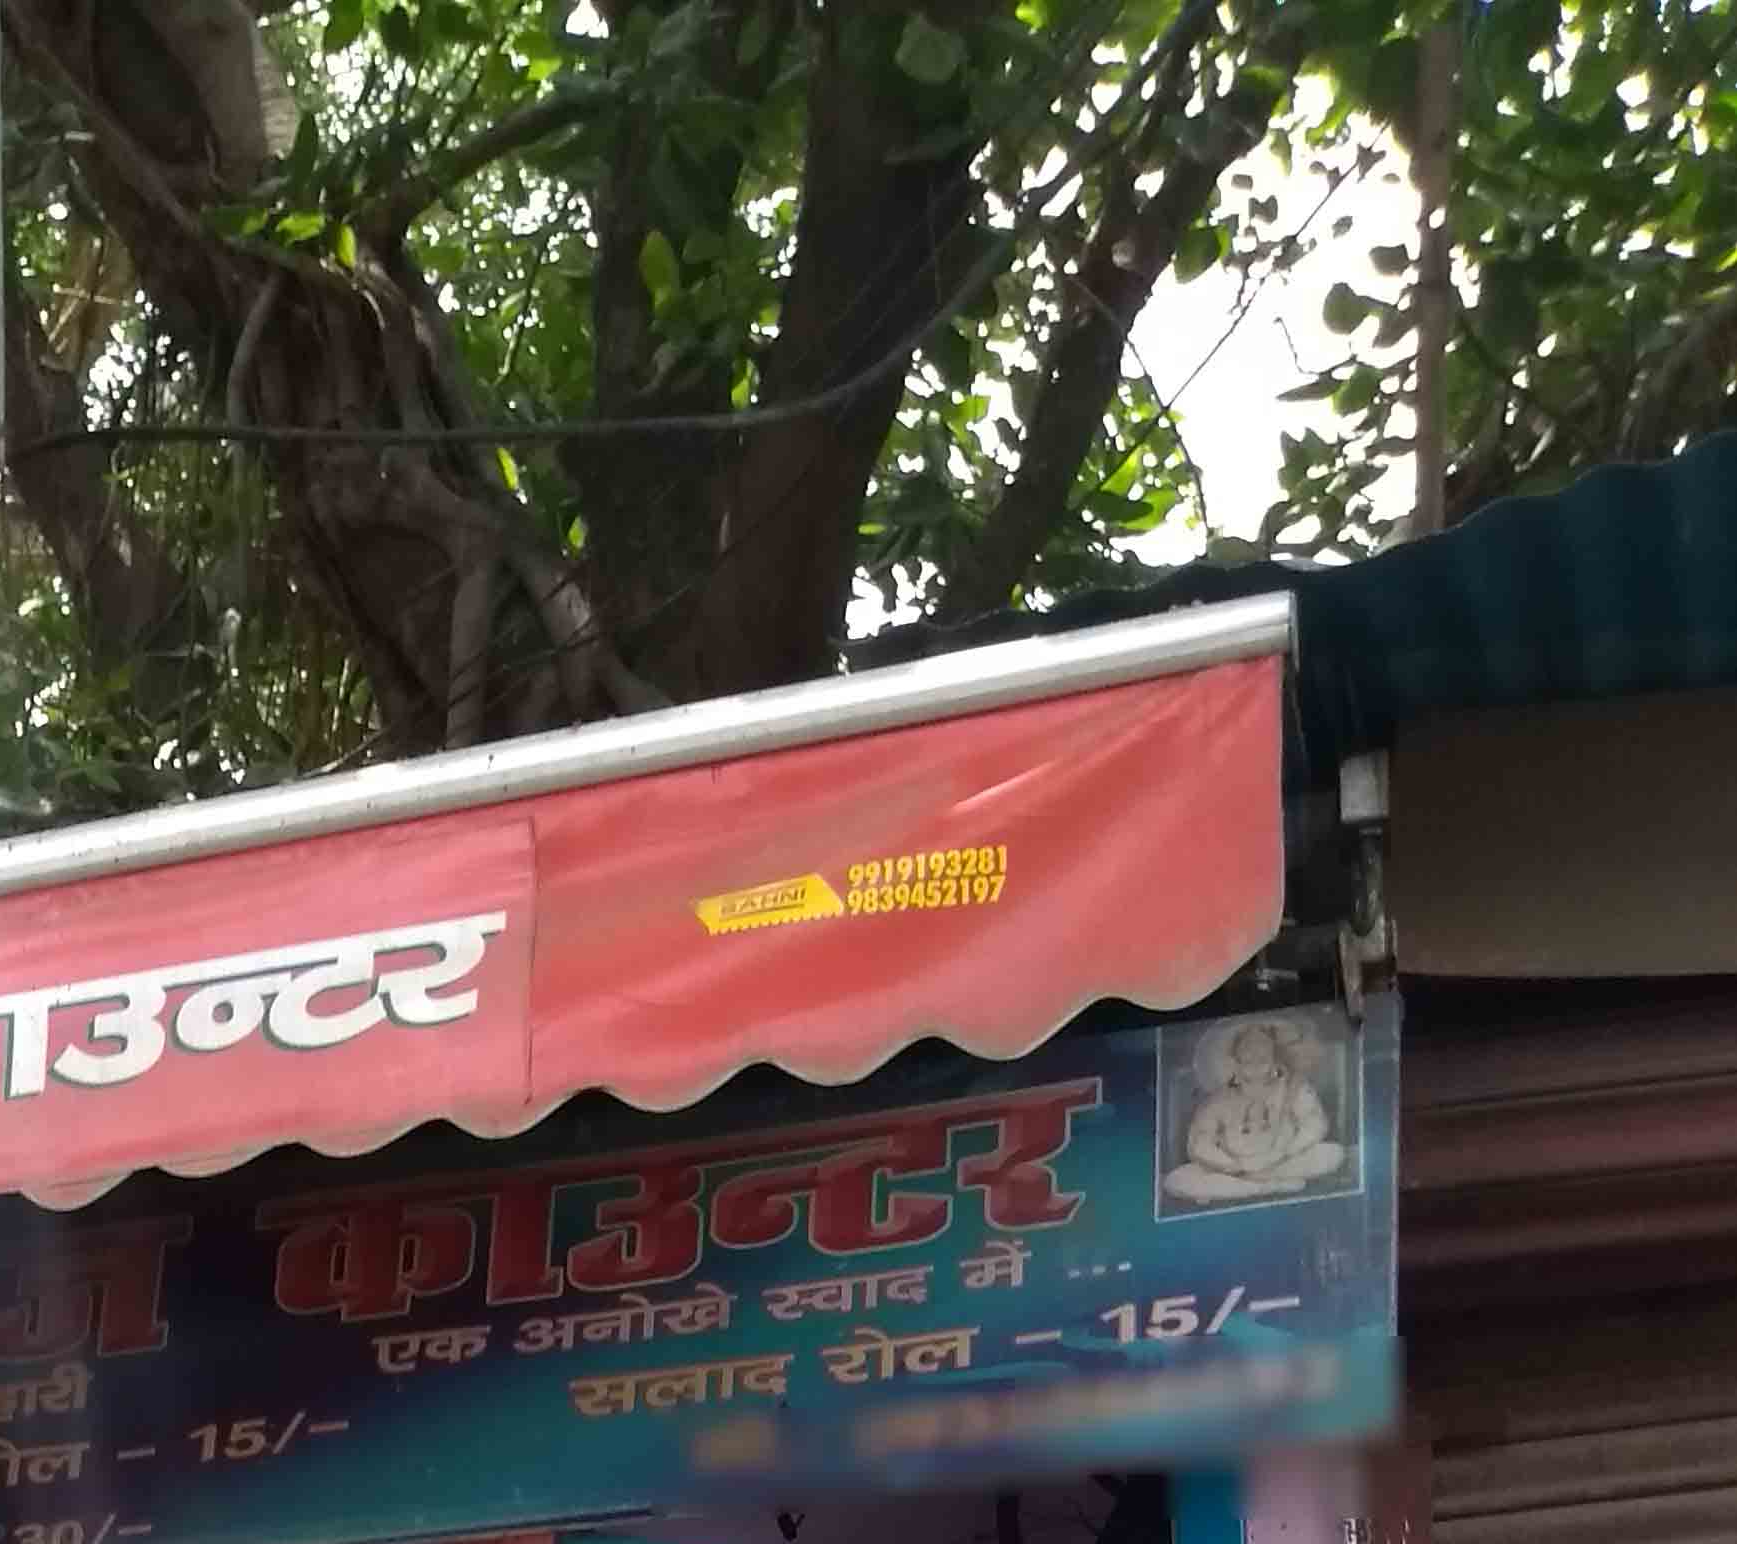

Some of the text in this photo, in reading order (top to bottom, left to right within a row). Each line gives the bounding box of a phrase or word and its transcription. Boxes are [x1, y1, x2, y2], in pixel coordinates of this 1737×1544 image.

[846, 875, 1007, 915] 9839452197
[847, 846, 1009, 888] 9919193281
[255, 1076, 1102, 1323] काउन्टर
[371, 1323, 491, 1373] एक
[515, 1280, 738, 1355] अनोखे
[766, 1262, 934, 1320] स्वाद
[959, 1238, 1033, 1291] में
[568, 1350, 796, 1419] सलाद
[823, 1318, 982, 1386] रोल
[1099, 1286, 1301, 1346] 15/-
[189, 1408, 352, 1467] 15/-
